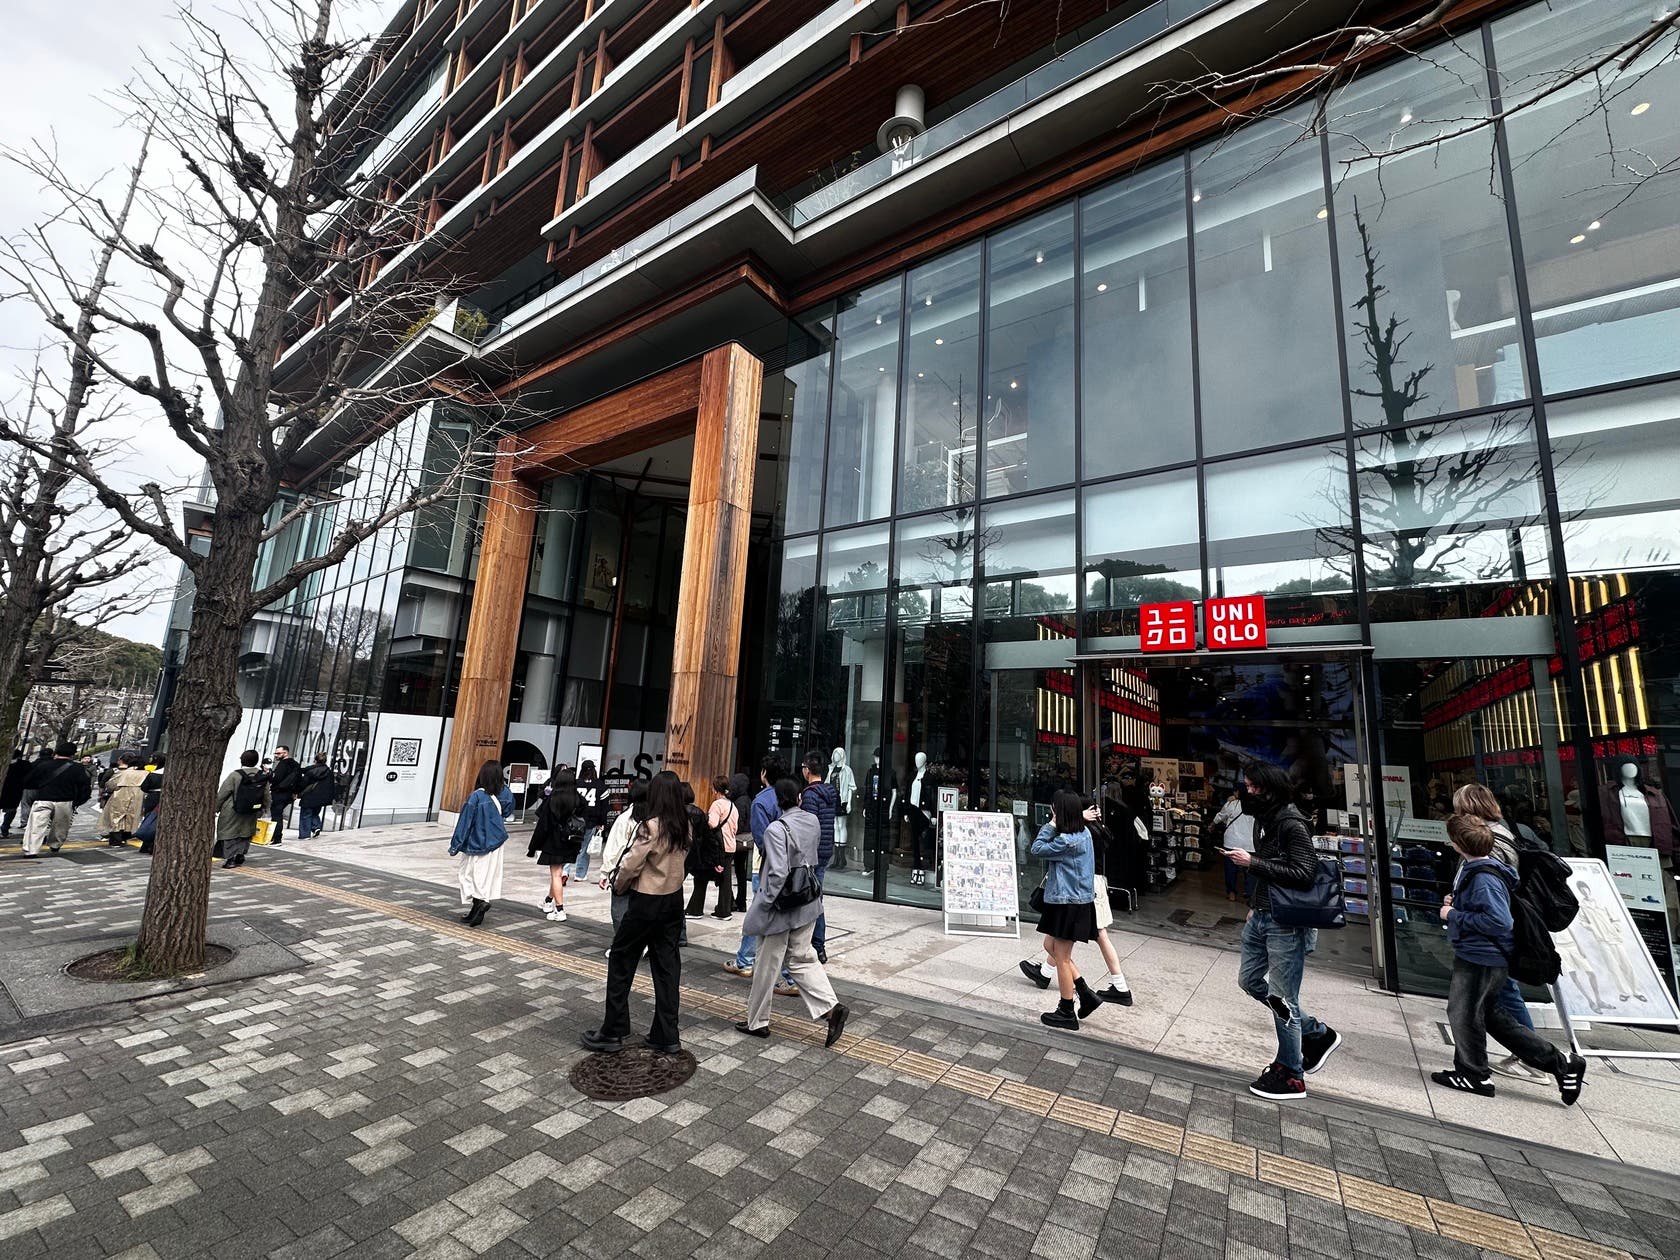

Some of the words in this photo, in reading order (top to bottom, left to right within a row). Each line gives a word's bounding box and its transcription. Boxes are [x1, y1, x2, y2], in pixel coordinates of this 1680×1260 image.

[1147, 607, 1185, 625] ユニ
[1212, 602, 1253, 622] UNI
[1146, 627, 1187, 645] クロ
[1213, 623, 1259, 645] QLO
[942, 792, 954, 803] UT
